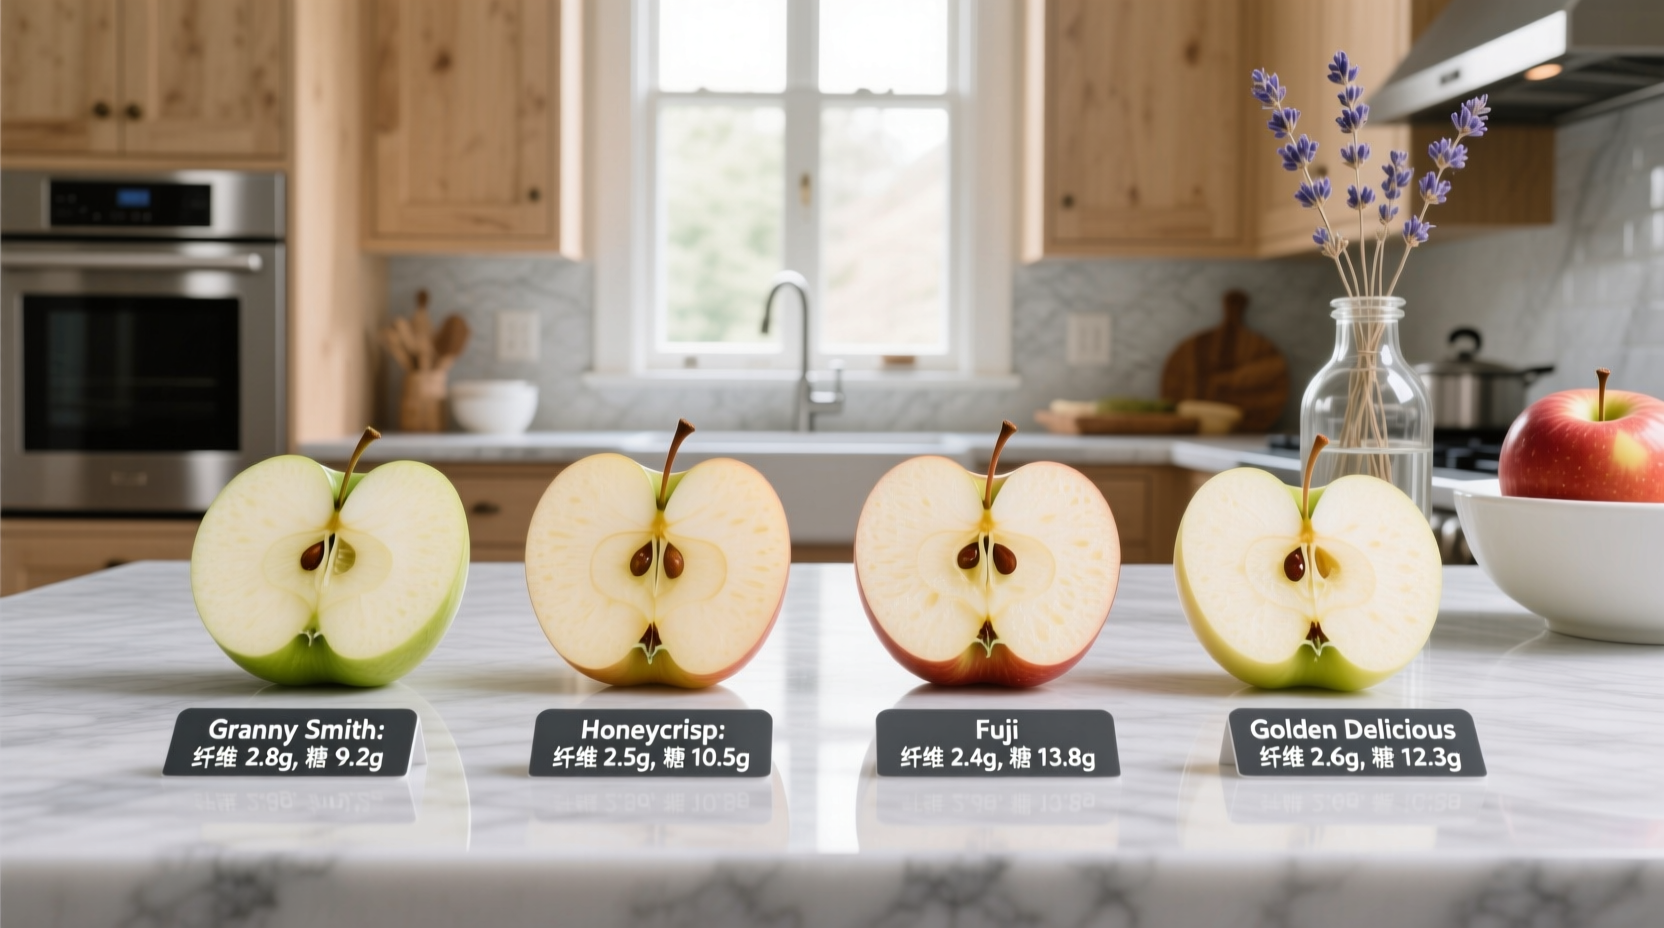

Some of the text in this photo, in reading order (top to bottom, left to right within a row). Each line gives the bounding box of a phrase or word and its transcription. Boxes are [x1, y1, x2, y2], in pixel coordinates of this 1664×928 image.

[209, 718, 384, 746] Granny Smith:
[582, 718, 725, 746] Honeycrisp:
[977, 718, 1018, 746] Fuji
[1251, 718, 1457, 740] Golden Delicious
[192, 746, 383, 772] 纤维 2.8g, 糖 9.2g
[553, 746, 749, 772] 纤维 2.5g, 糖 10.5g
[901, 746, 1096, 772] 纤维 2.4g, 糖 13.8g
[1260, 746, 1461, 772] 纤维 2.6g, 糖 12.3g
